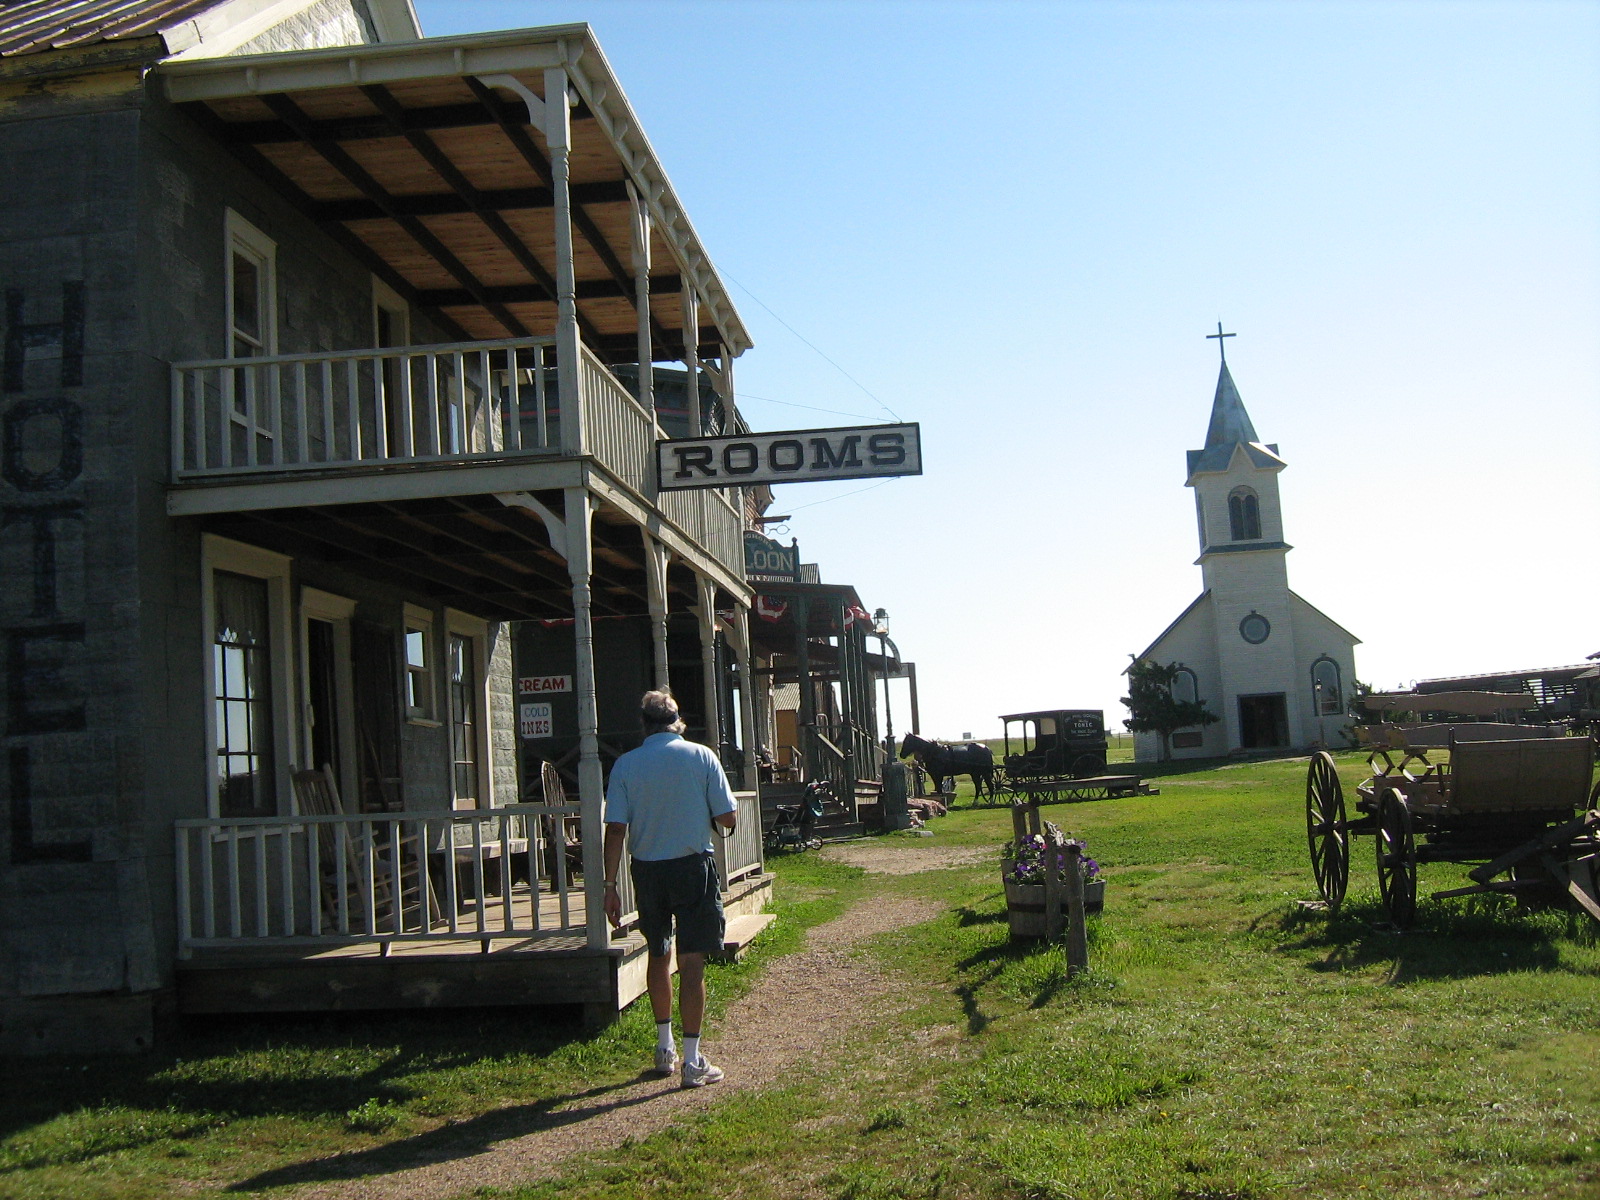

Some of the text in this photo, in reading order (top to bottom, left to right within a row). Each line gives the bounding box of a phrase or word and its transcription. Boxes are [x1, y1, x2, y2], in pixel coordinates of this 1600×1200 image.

[673, 433, 906, 478] ROOMS
[2, 279, 93, 865] HOTEL
[518, 677, 565, 692] CREAM
[524, 706, 549, 717] COLD
